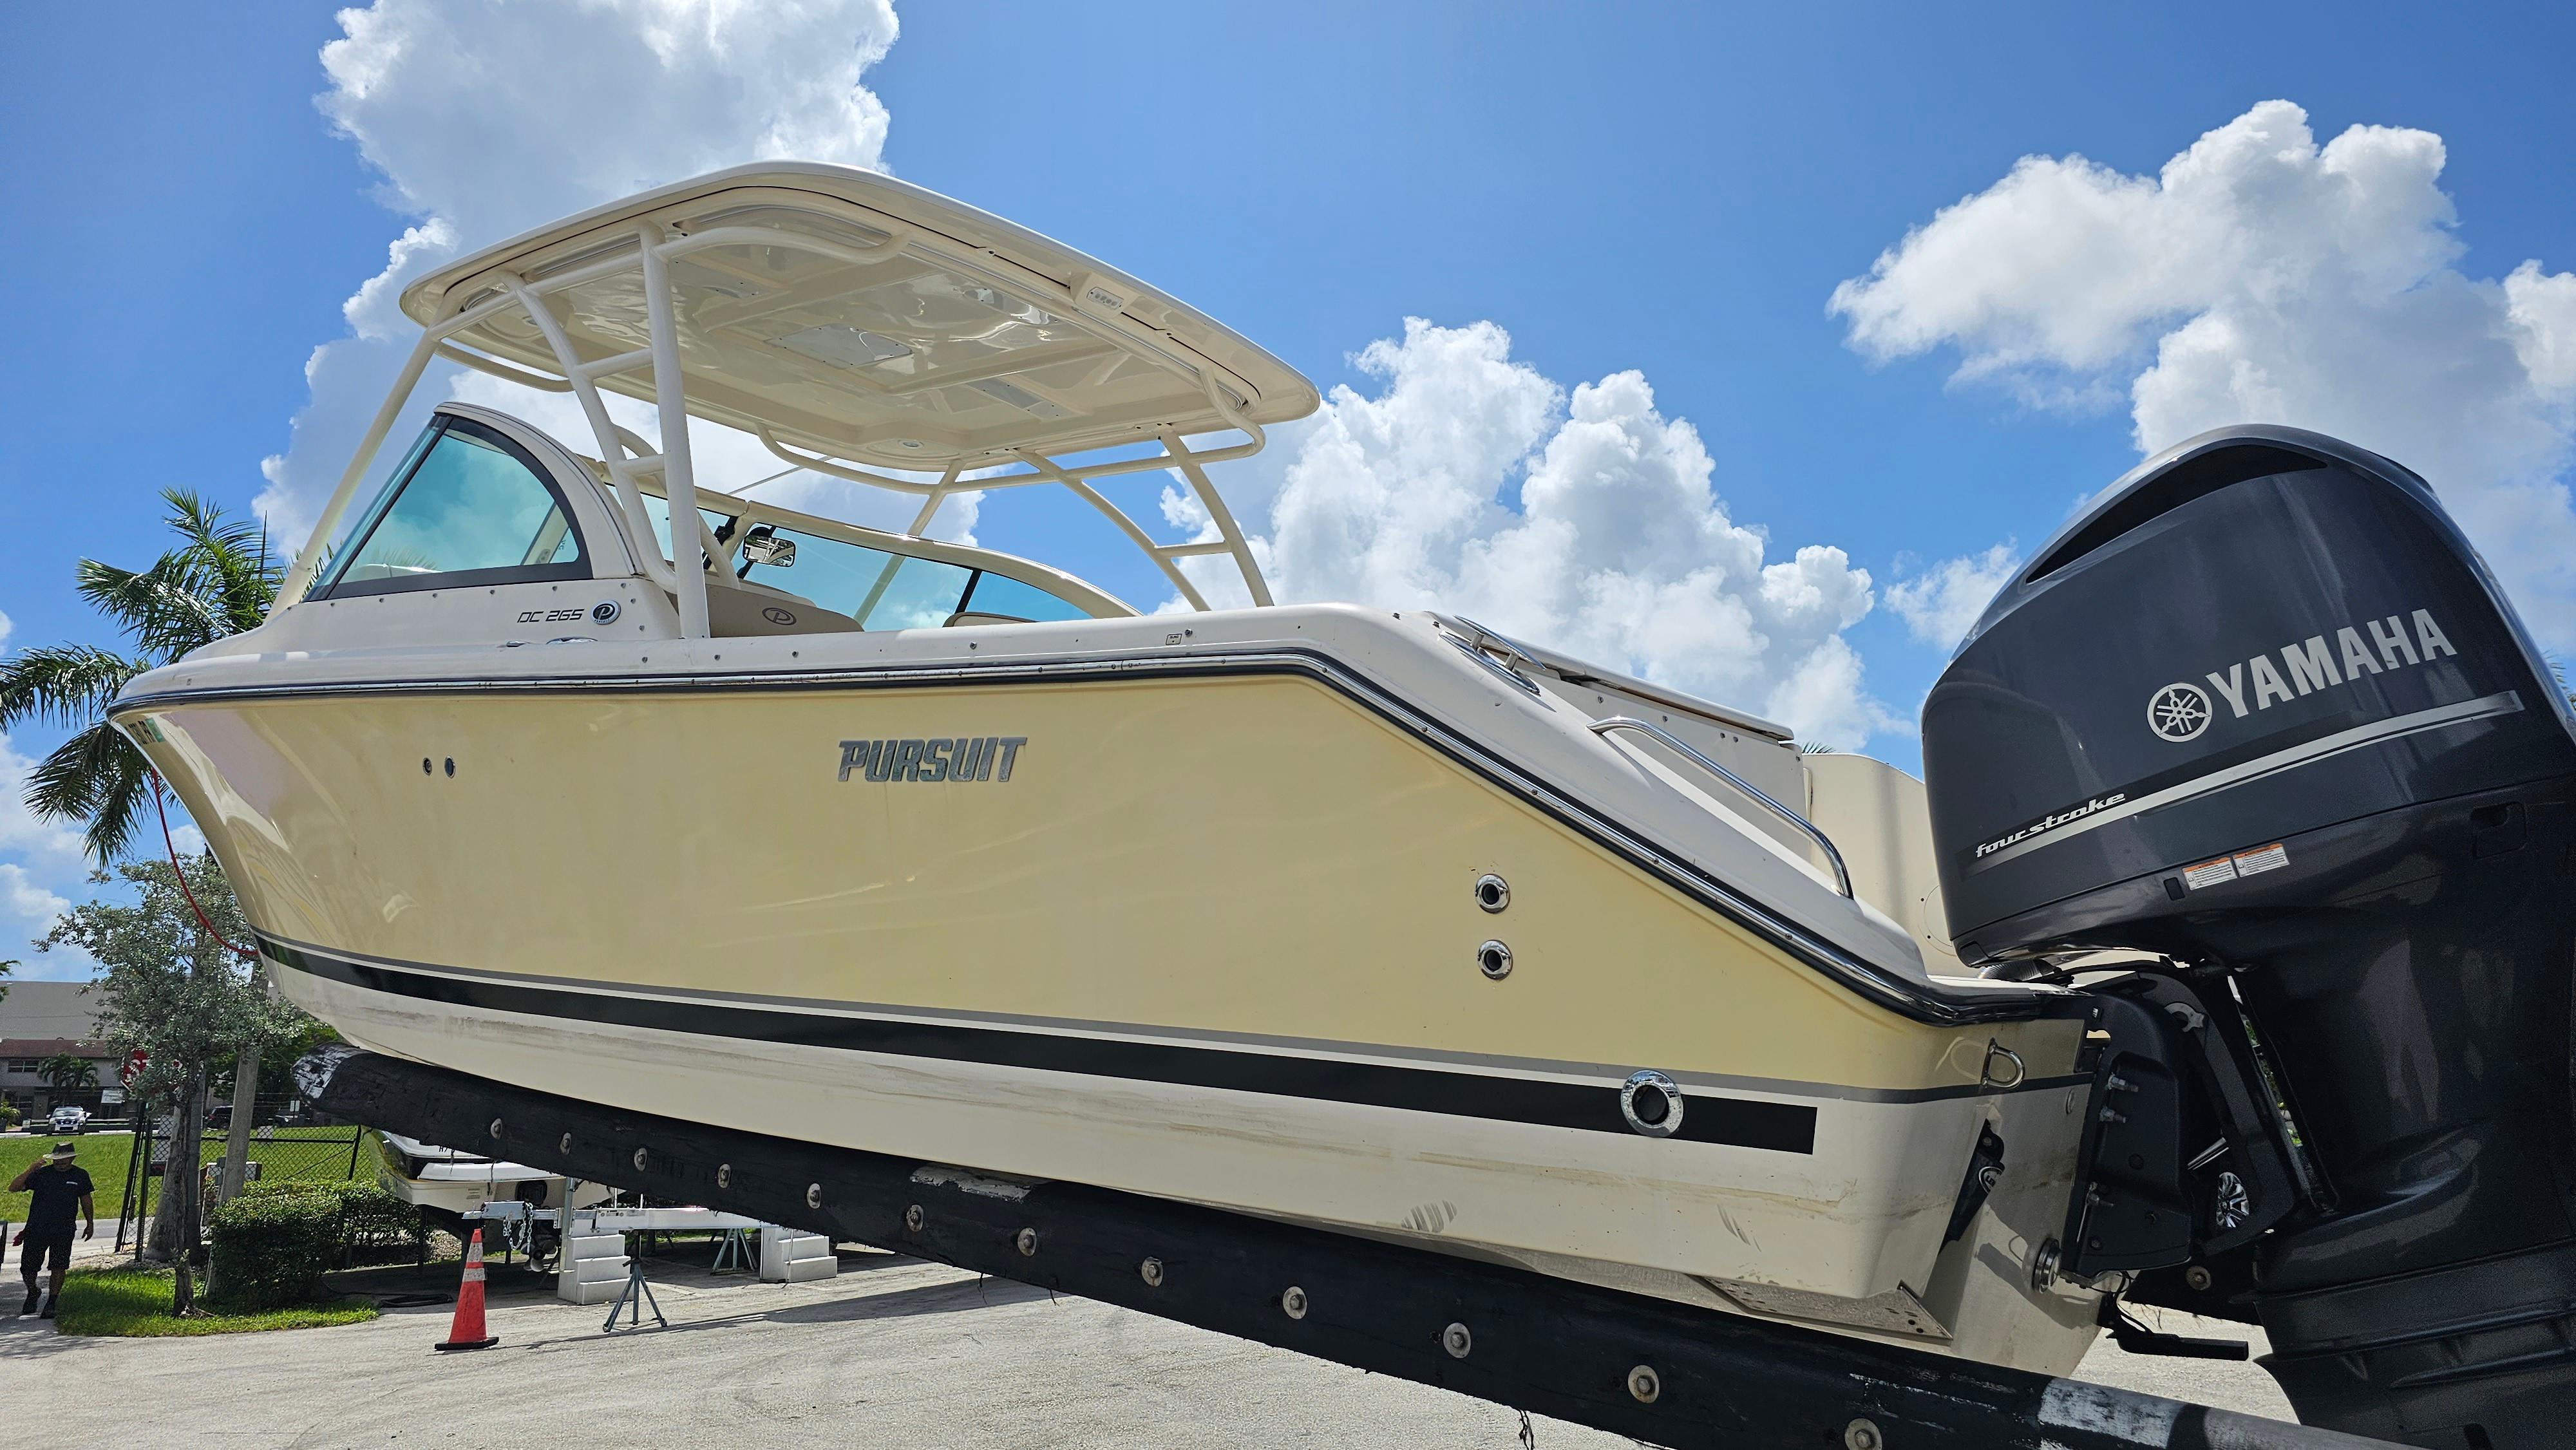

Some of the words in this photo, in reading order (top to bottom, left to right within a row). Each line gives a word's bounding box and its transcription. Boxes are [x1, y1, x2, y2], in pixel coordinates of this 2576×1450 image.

[516, 611, 544, 623] DC
[545, 608, 585, 622] 265
[2205, 608, 2458, 719] YAMAHA
[838, 737, 1028, 782] PURSUIT
